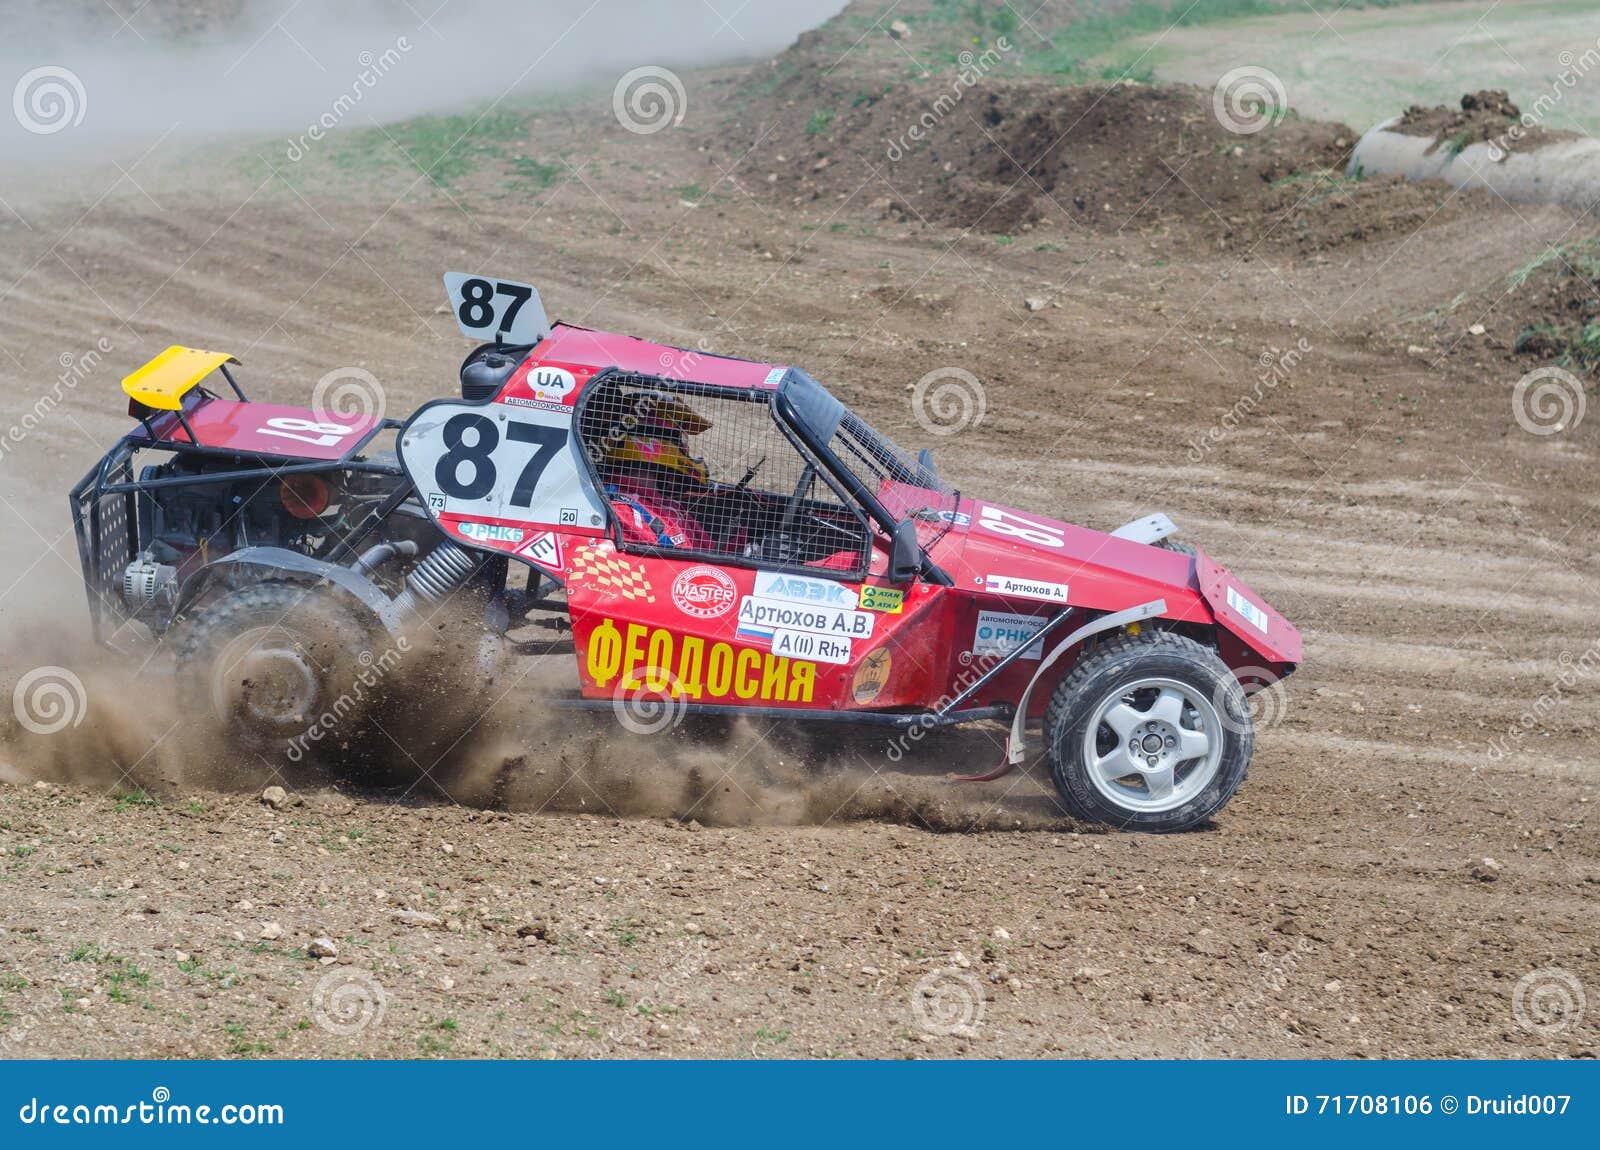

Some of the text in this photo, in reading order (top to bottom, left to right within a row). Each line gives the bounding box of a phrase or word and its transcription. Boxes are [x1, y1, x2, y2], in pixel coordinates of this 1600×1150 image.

[458, 278, 532, 333] 87
[537, 372, 564, 389] UA
[507, 398, 572, 413] АВТОМОТОКРОСС
[434, 412, 569, 508] 87
[431, 497, 444, 508] 73
[562, 512, 576, 523] 20
[978, 505, 1065, 548] 87
[675, 583, 734, 602] MASTER
[877, 590, 900, 599] ATAN
[1004, 580, 1065, 598] Артюхов А.
[876, 601, 899, 610] ATAN
[740, 599, 827, 629] Артюхов
[832, 612, 870, 635] А.В.
[818, 640, 849, 658] Rh+
[586, 617, 818, 702] ФЕОДОСИЯ
